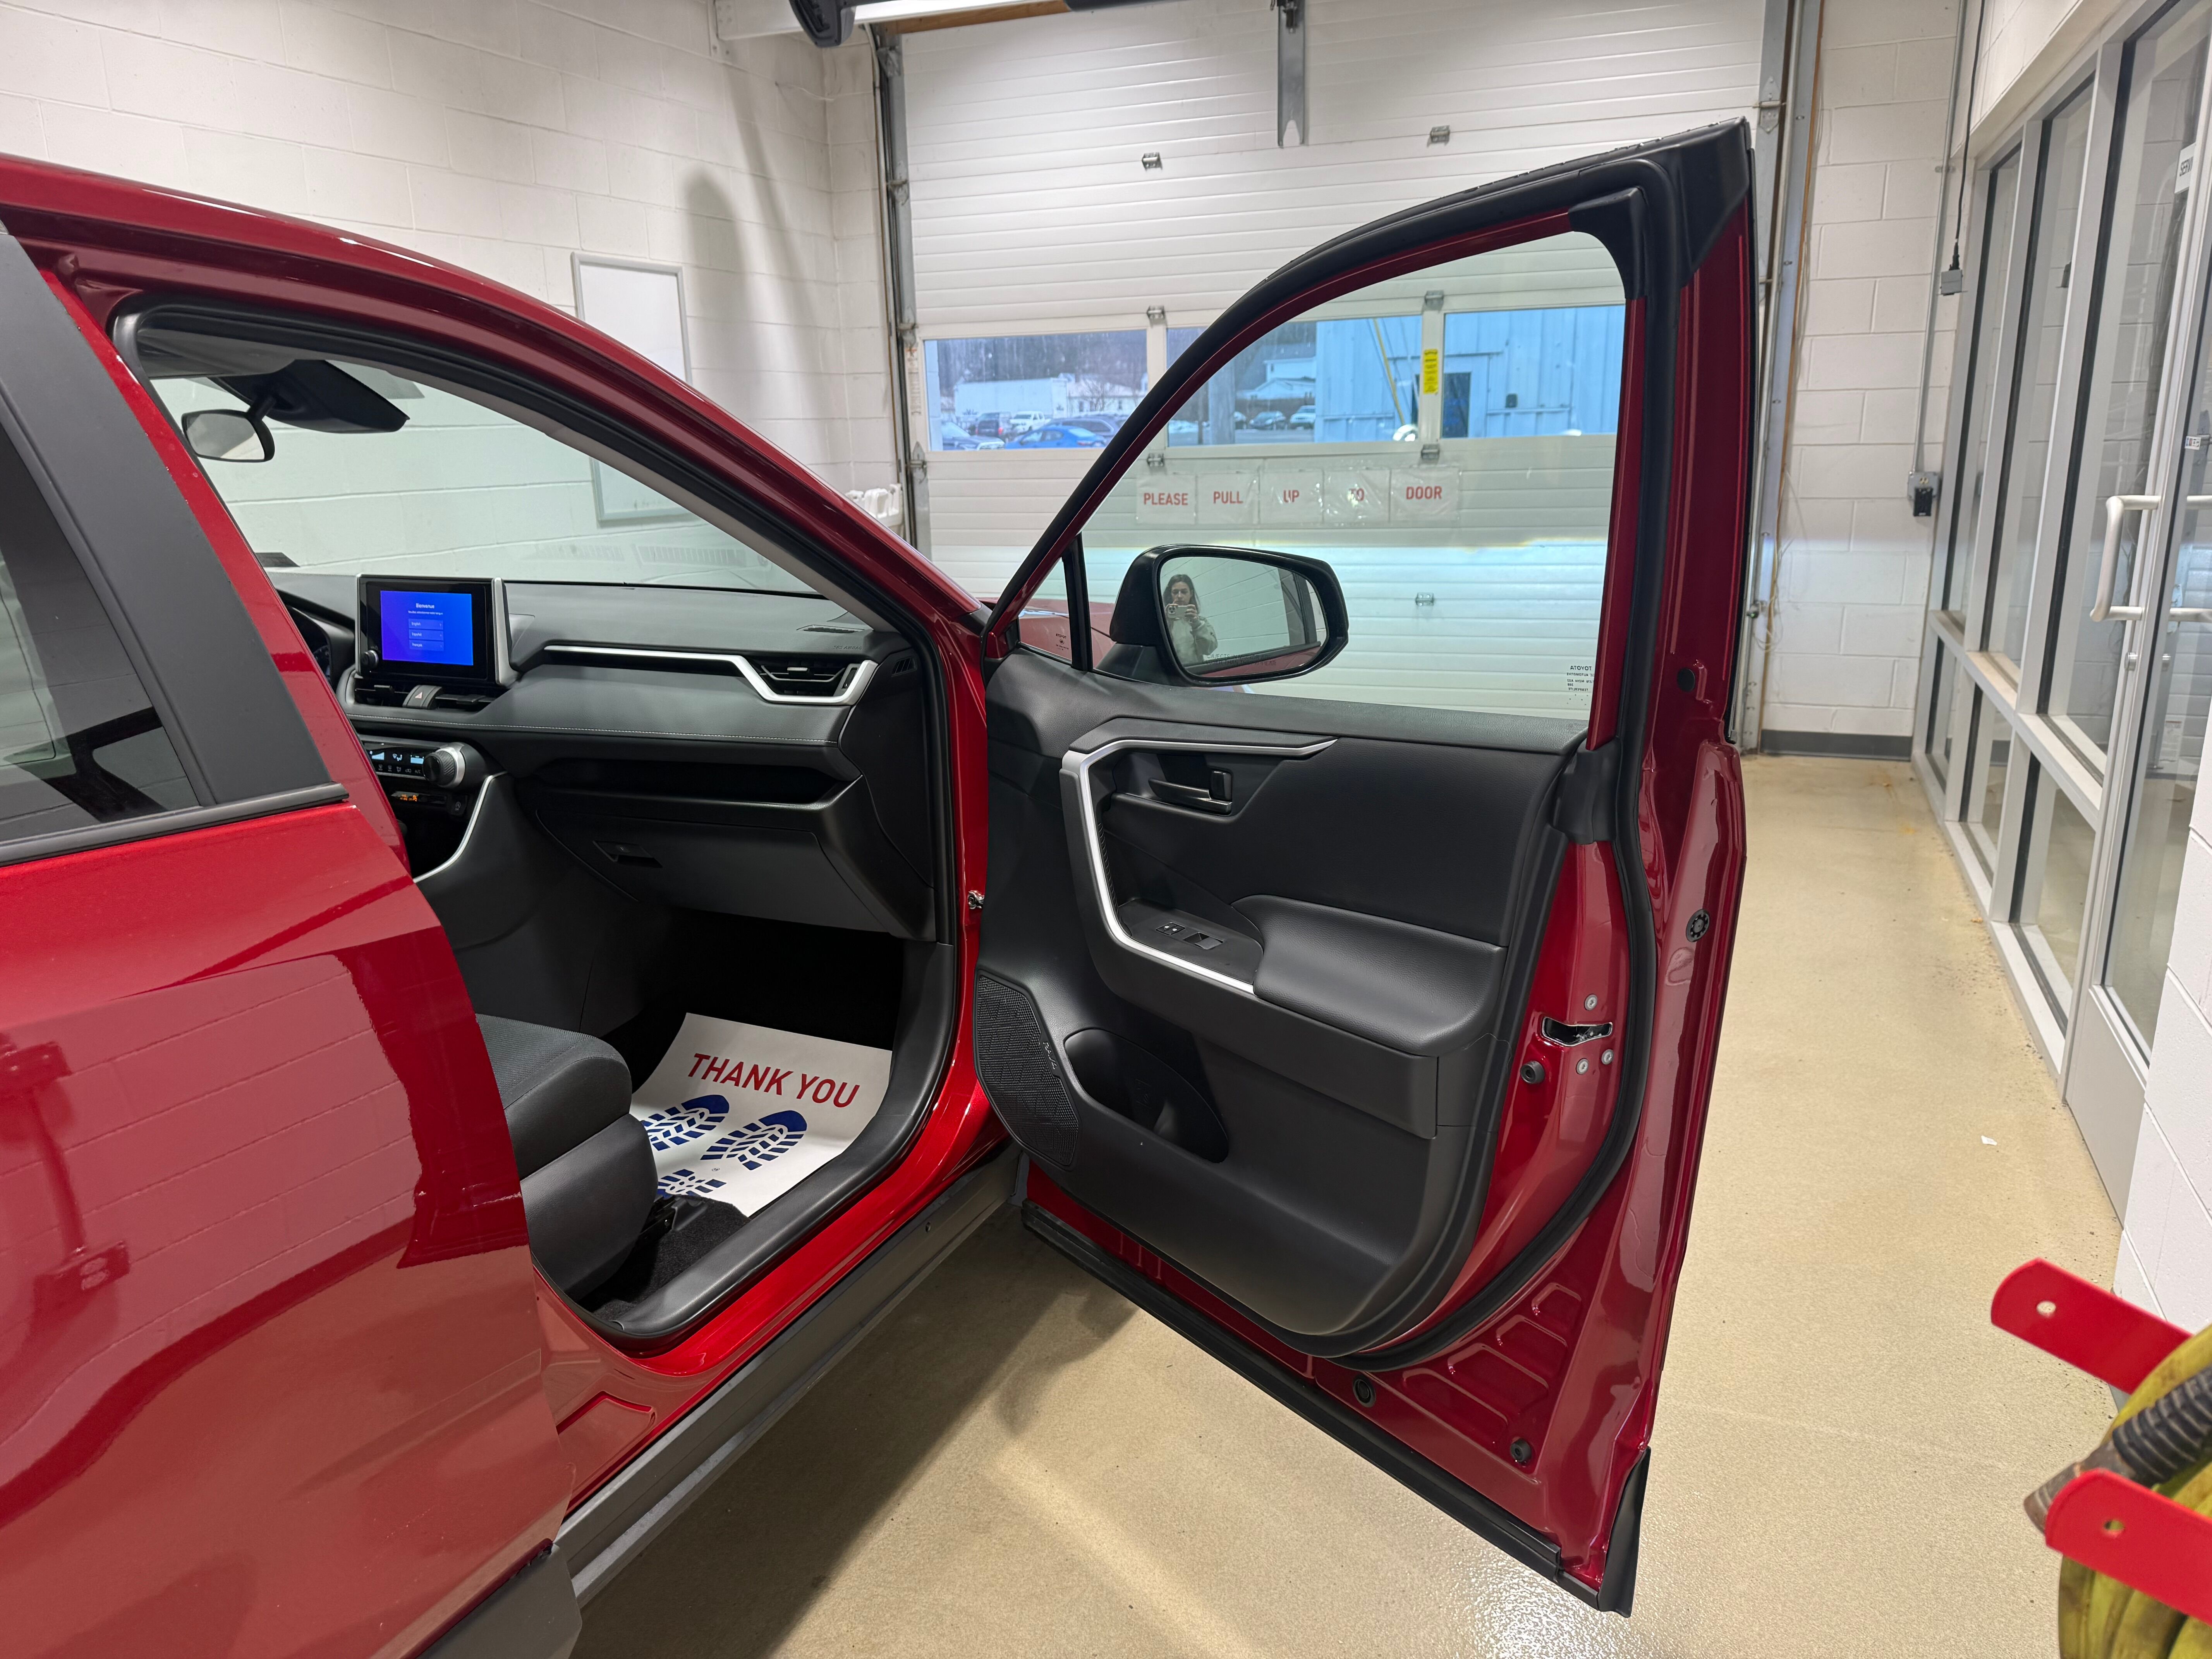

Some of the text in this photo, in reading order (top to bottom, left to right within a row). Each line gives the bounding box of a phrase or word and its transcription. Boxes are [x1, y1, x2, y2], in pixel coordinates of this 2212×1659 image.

[1144, 492, 1188, 506] PLEASE
[1213, 491, 1243, 504] PULL
[1283, 489, 1300, 503] UP
[1406, 486, 1442, 500] DOOR
[688, 1053, 860, 1108] THANK YOU
